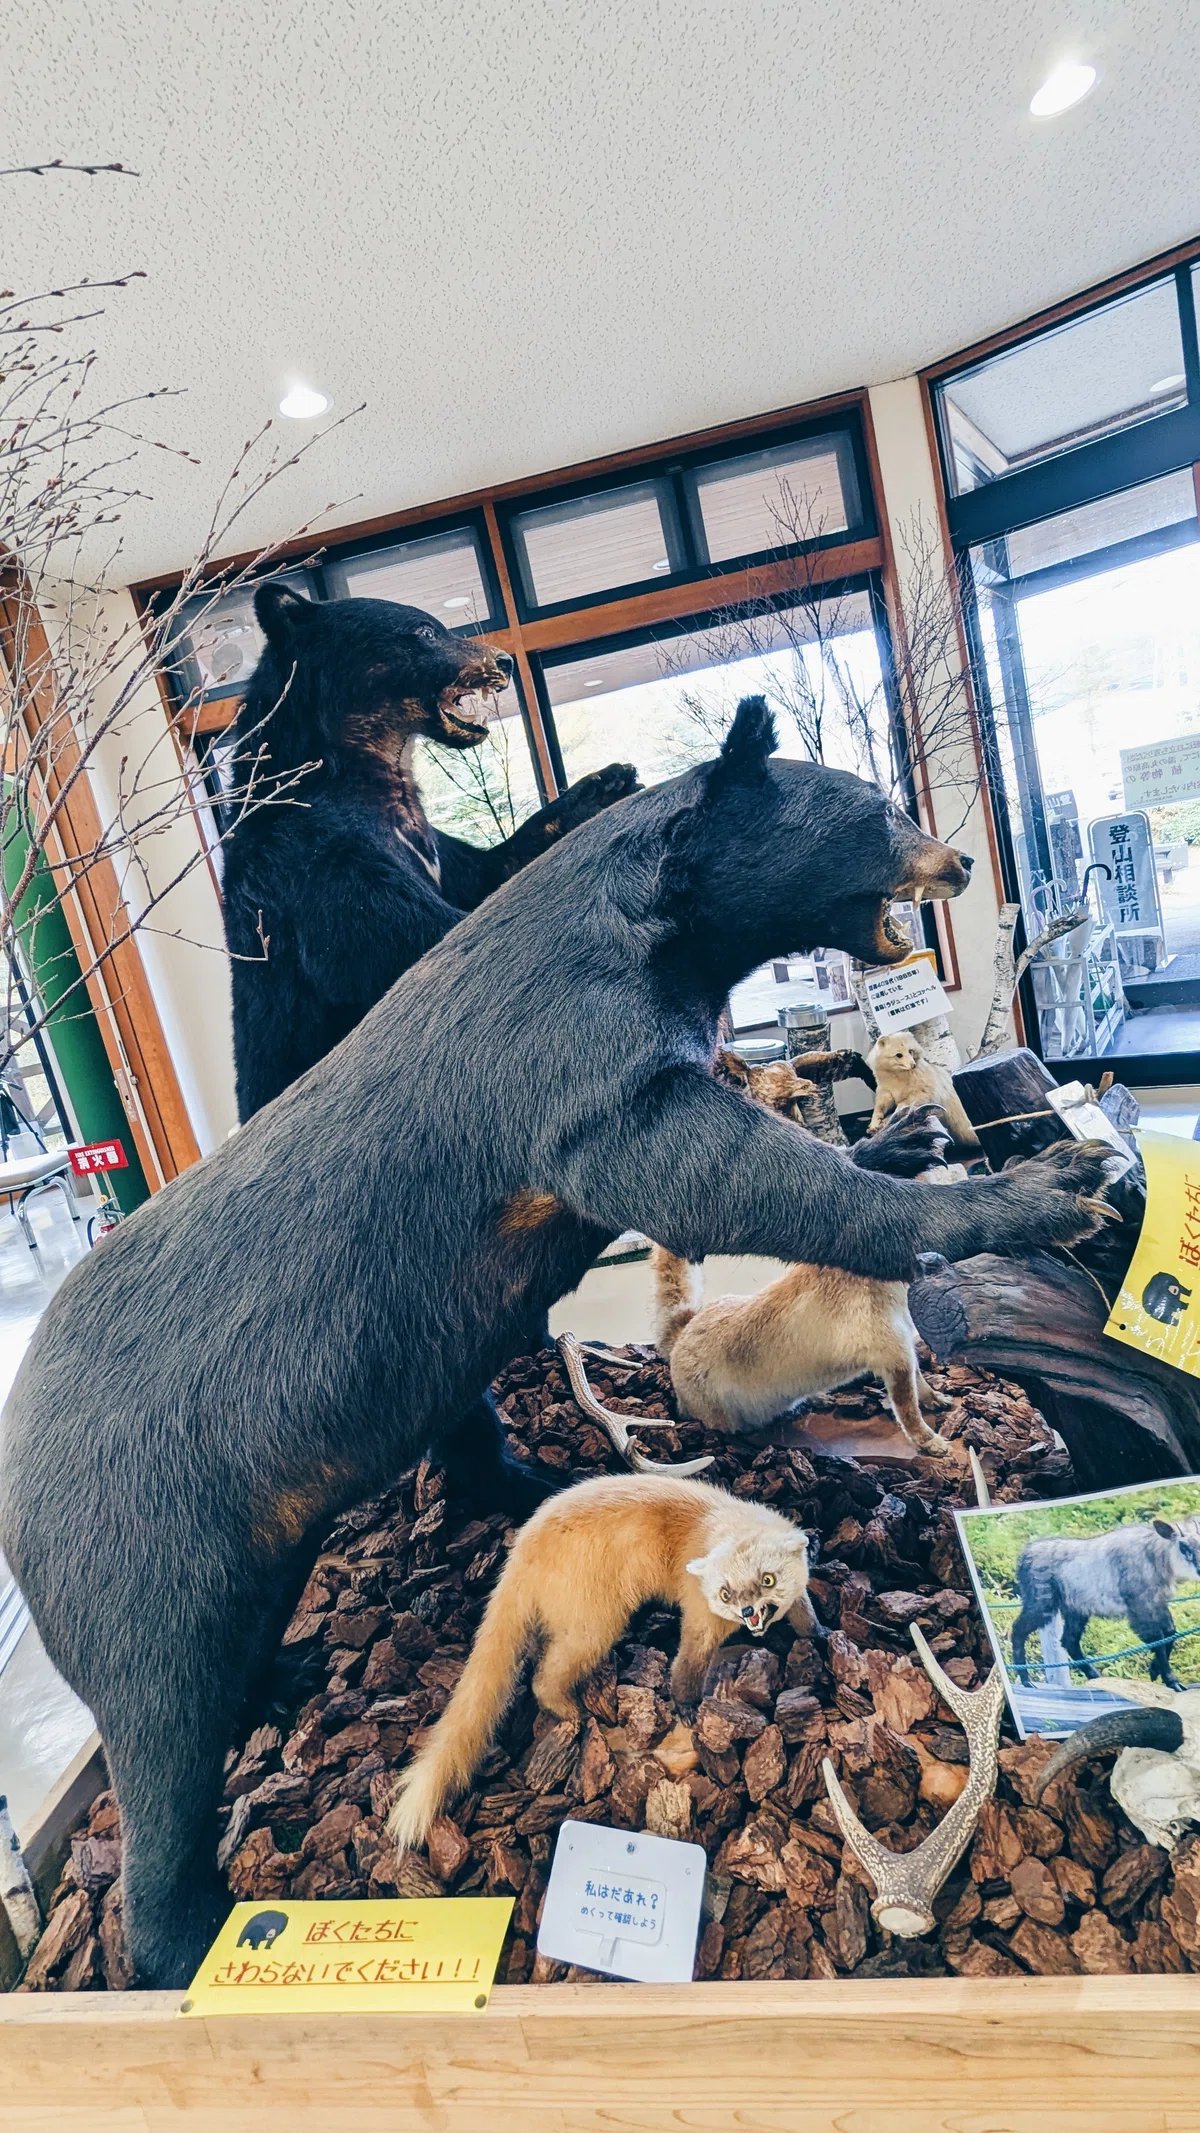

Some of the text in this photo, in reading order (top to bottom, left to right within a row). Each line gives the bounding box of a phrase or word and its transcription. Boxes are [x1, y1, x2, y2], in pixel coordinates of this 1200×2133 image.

[1108, 823, 1140, 924] 登山相談所
[77, 1151, 119, 1170] 消火器
[584, 1880, 659, 1910] 私はだあれ？
[304, 1918, 419, 1942] ぼくたちに
[580, 1906, 657, 1930] めくって確認しよう
[213, 1957, 481, 1984] さわらないでください！！
